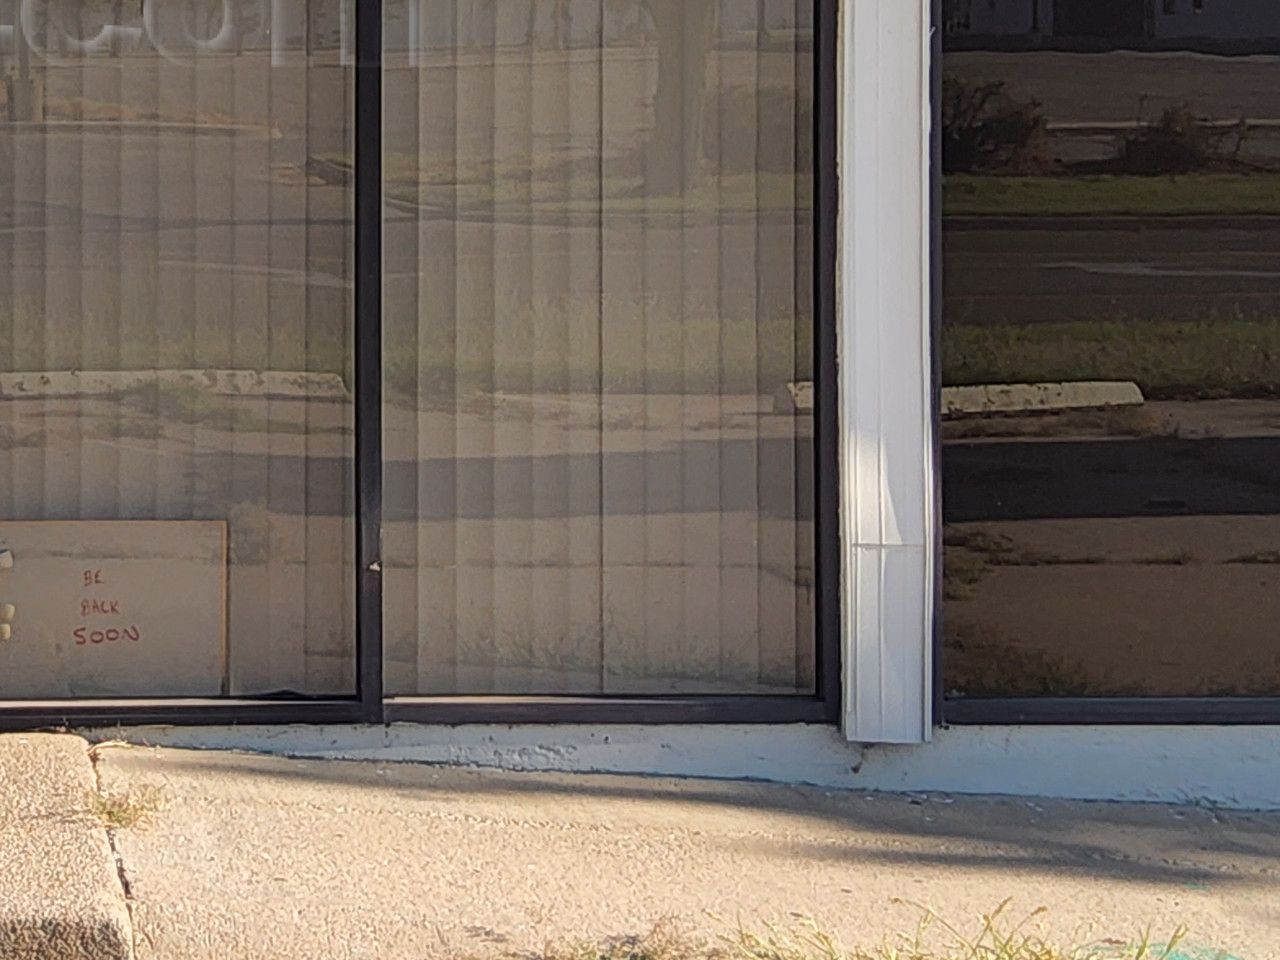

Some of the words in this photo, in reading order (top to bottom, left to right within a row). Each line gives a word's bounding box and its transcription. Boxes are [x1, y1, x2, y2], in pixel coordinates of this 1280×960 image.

[83, 569, 104, 586] BE
[80, 599, 121, 617] BACK
[73, 625, 140, 646] SOON
